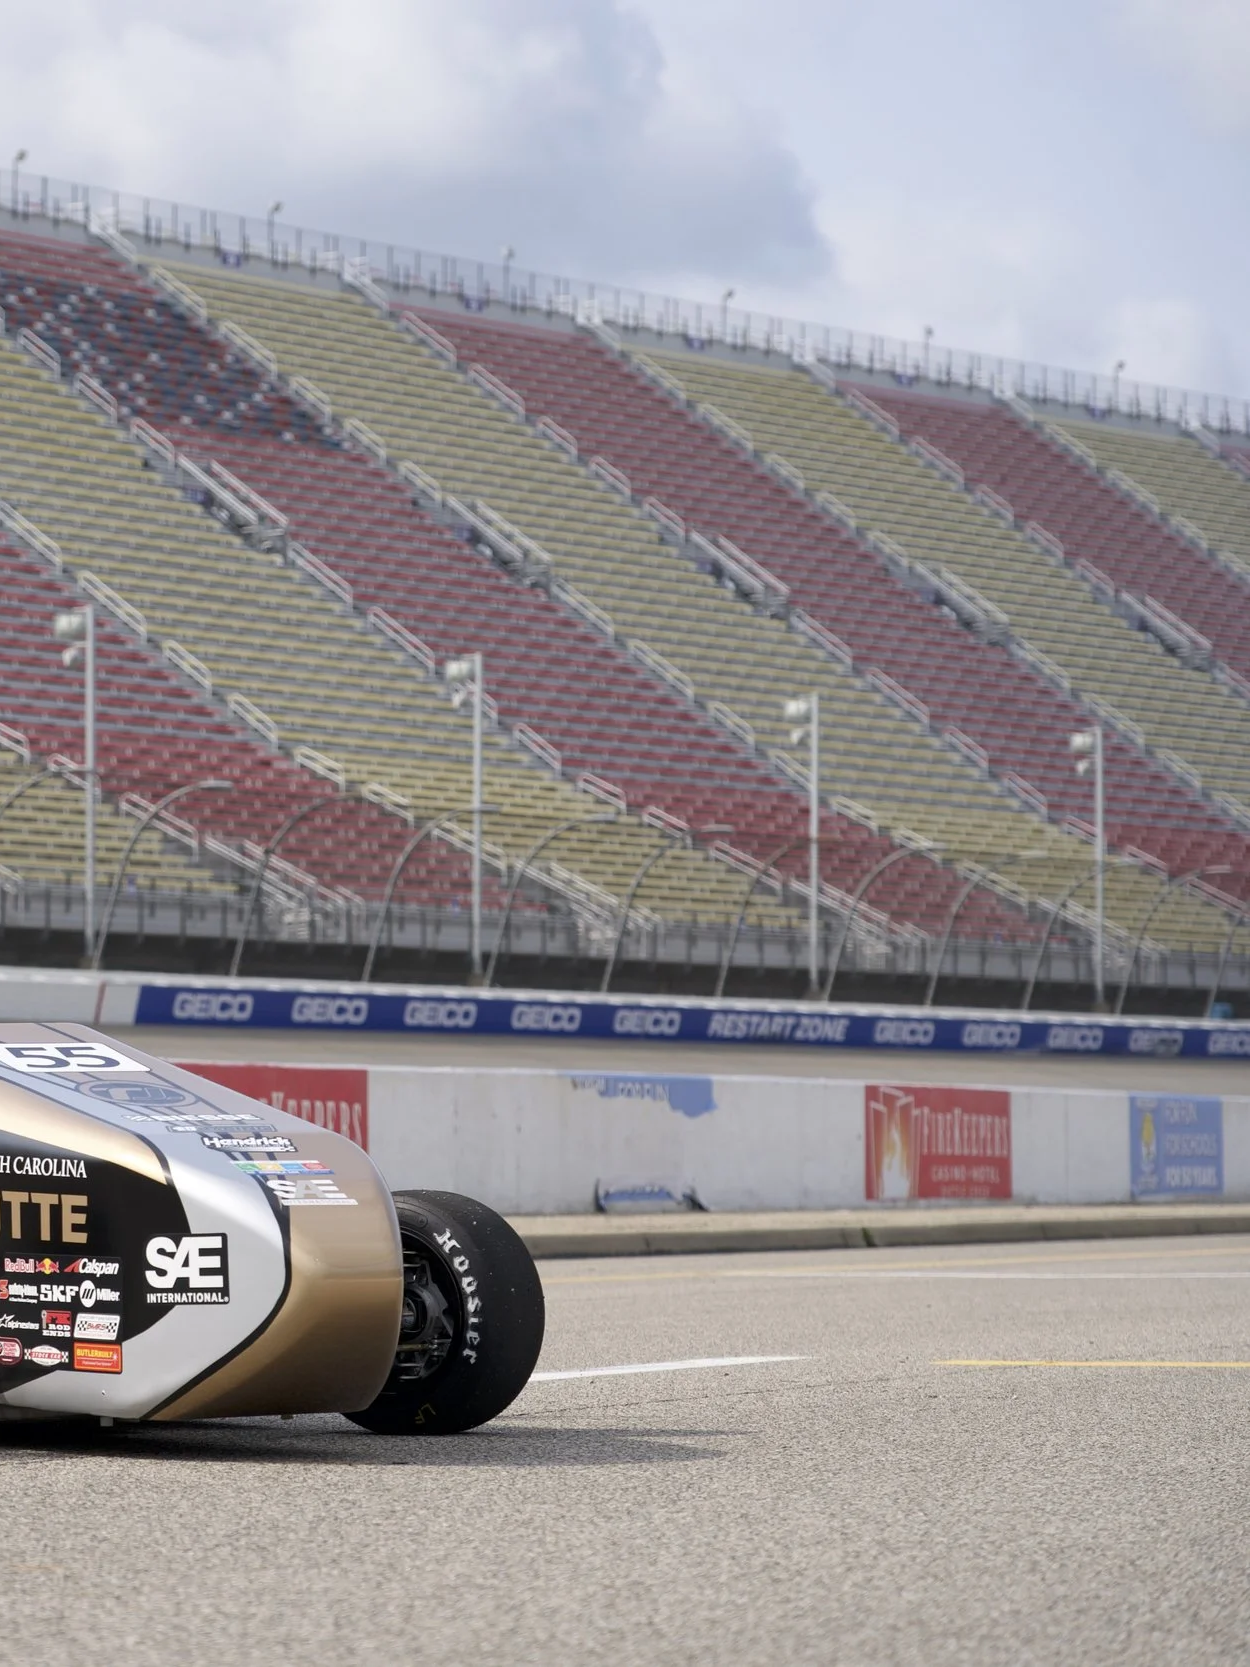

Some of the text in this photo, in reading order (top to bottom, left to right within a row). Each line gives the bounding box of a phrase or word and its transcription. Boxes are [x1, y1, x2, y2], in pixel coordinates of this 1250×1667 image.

[172, 990, 254, 1022] GEICO
[291, 995, 368, 1025] GEICO
[403, 999, 478, 1028] GEICO
[510, 1003, 582, 1033] GEICO
[613, 1008, 681, 1036] GEICO
[707, 1012, 850, 1042] RESTART ZONE
[873, 1019, 935, 1046] GEICO
[961, 1022, 1021, 1048] GEICO
[1046, 1026, 1103, 1050] GEICO
[1207, 1031, 1250, 1055] GEIC
[5, 1046, 120, 1068] 55
[203, 1136, 291, 1148] Hendrick
[12, 1156, 88, 1179] CAROLINA
[78, 1258, 120, 1277] Calspan
[145, 1236, 224, 1289] SAE
[40, 1284, 79, 1303] SKF
[146, 1292, 225, 1304] INTERNATIONAL
[434, 1228, 483, 1365] Hoosier
[42, 1330, 71, 1338] ENDS
[48, 1323, 71, 1331] ROD
